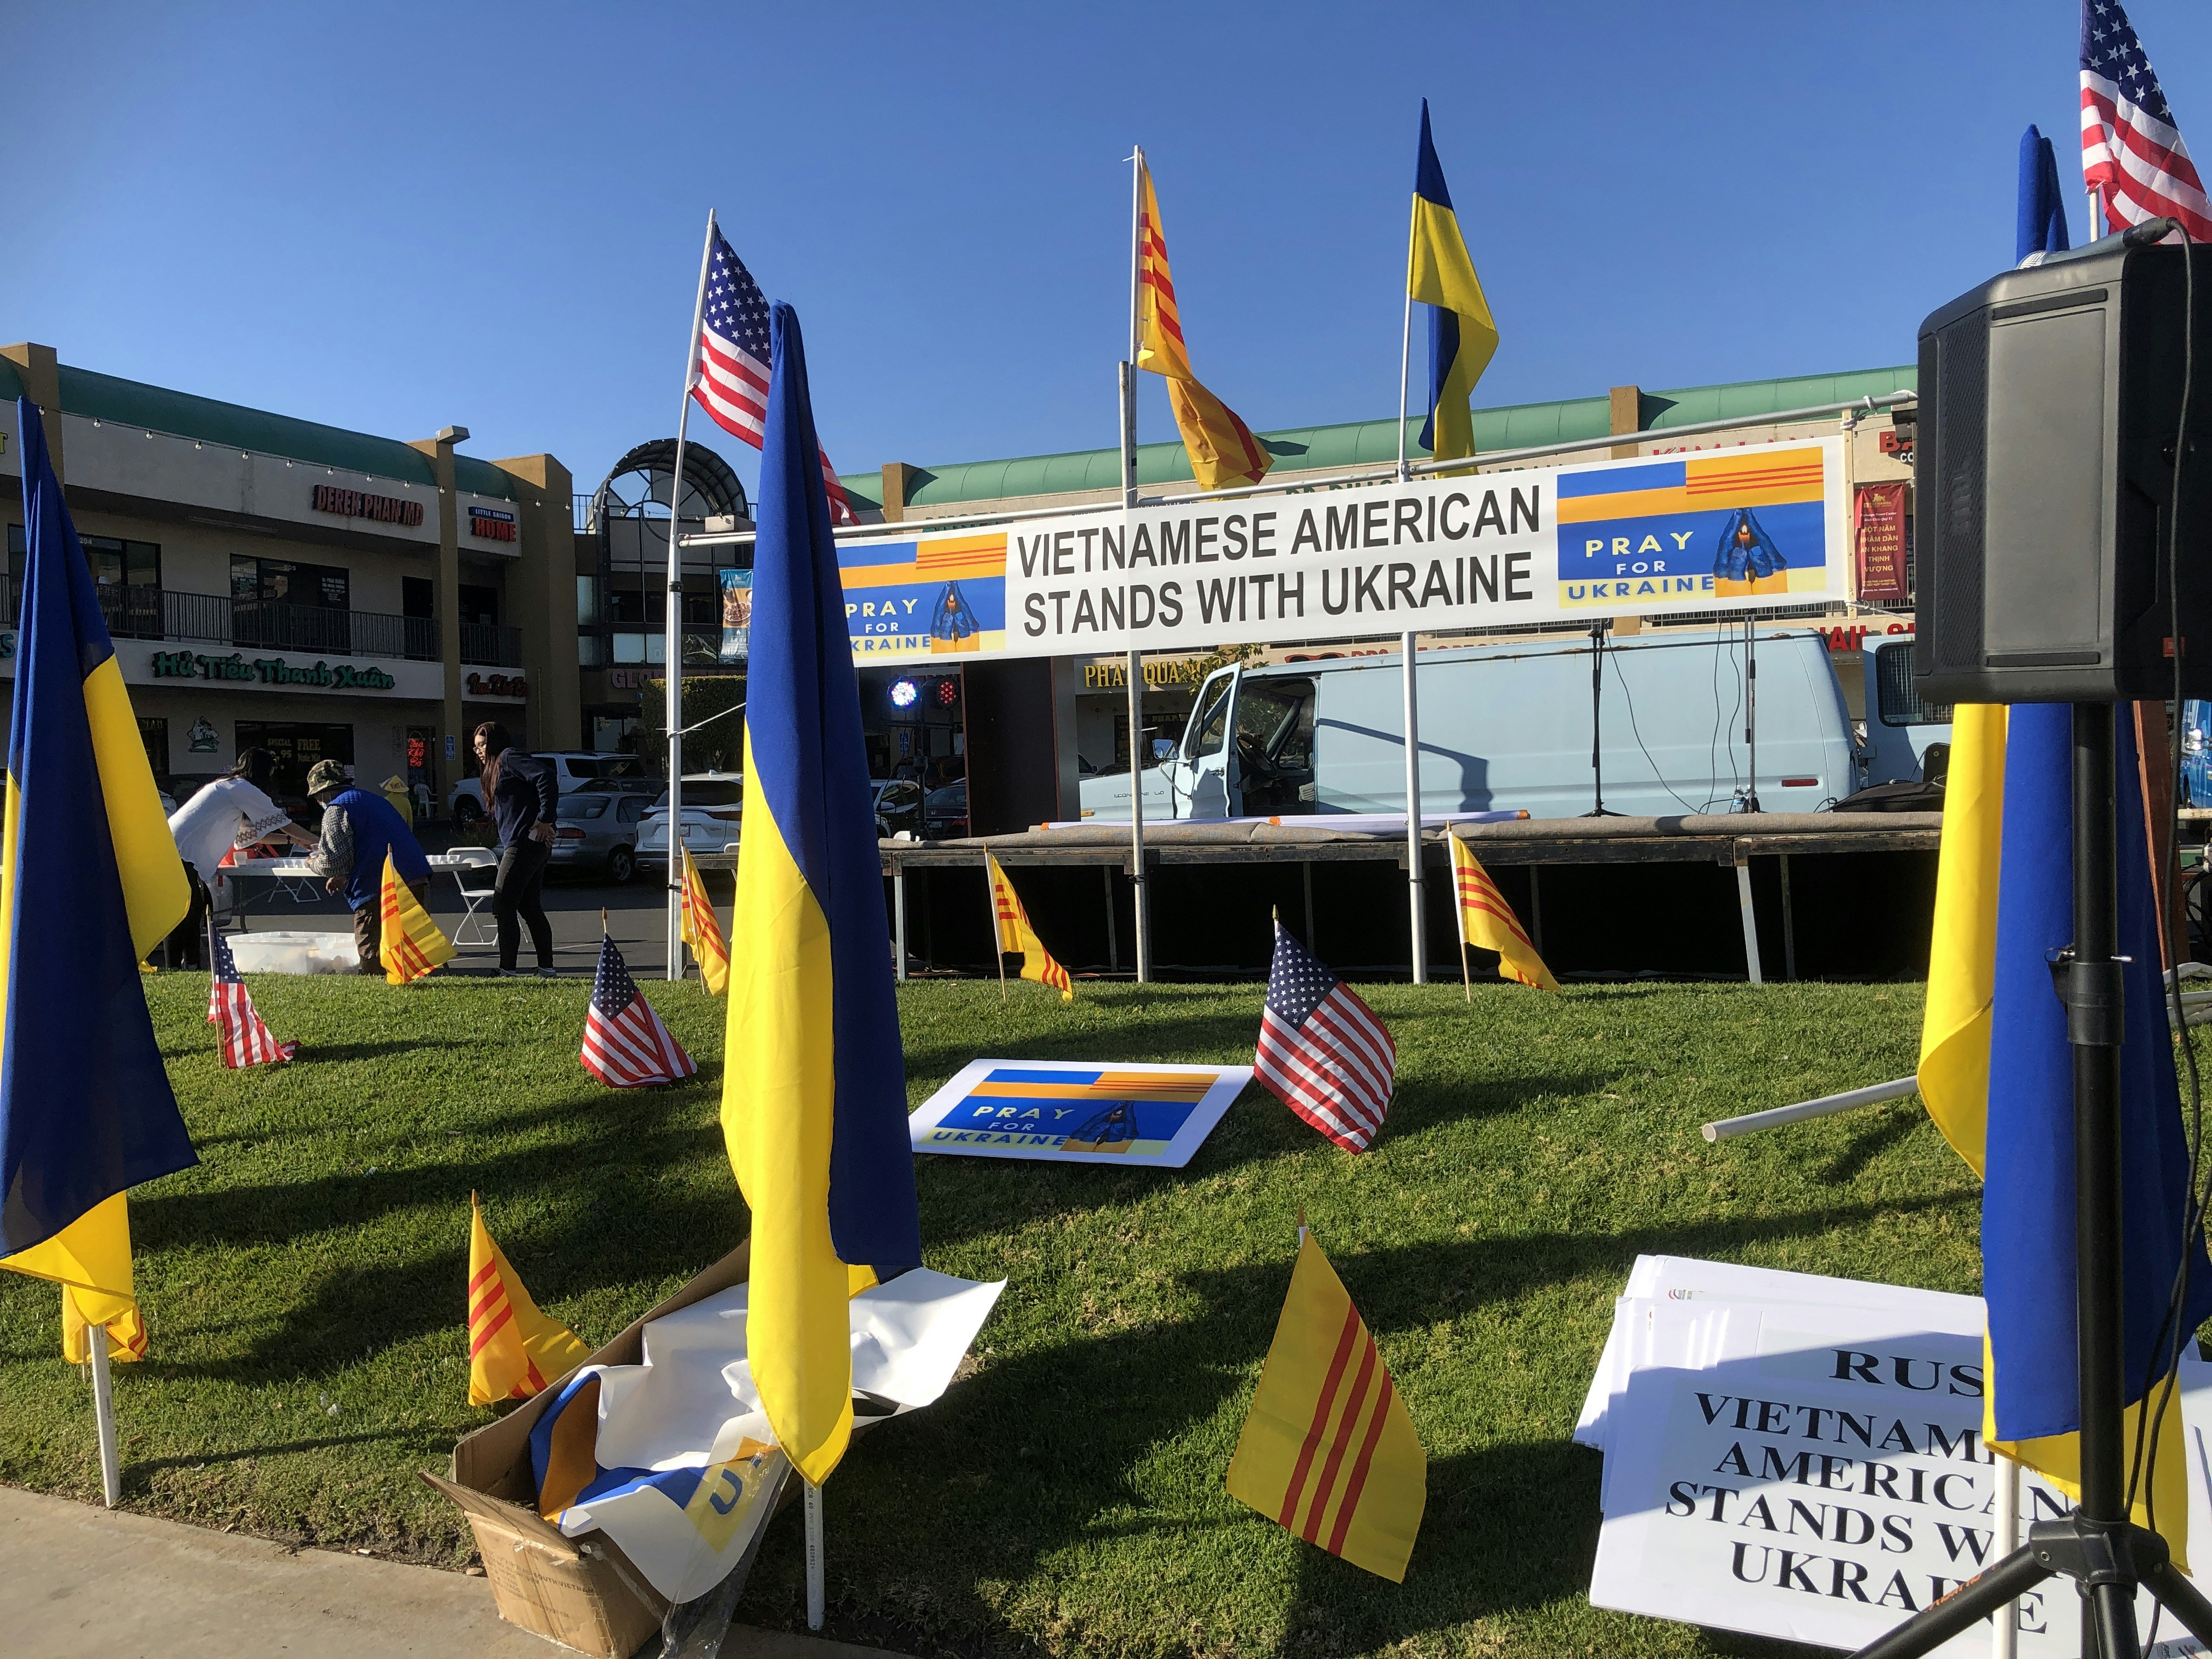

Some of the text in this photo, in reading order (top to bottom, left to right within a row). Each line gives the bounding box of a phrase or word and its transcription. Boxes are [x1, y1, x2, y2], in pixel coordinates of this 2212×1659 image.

[316, 484, 424, 526] DEREK PHAN MD
[493, 511, 511, 520] SAIGON
[475, 517, 516, 542] HOME
[1018, 485, 1539, 578] VIETNAMESE AMERICAN
[1585, 531, 1694, 557] PRAY
[1616, 560, 1666, 575] FOR
[1864, 565, 1893, 573] VƯỢNG
[1024, 552, 1533, 636] STANDS WITH UKRAINE
[1568, 576, 1714, 600] UKRAINE
[845, 599, 918, 618] PRAY
[865, 622, 899, 634] FOR
[851, 636, 930, 651] KRAINE
[255, 658, 332, 686] Thanh
[332, 664, 395, 690] Xuân
[1084, 664, 1128, 687] PHA
[297, 738, 321, 751] FREE
[972, 1106, 1074, 1120] PRAY
[988, 1122, 1035, 1131] FOR
[934, 1131, 1073, 1146] UKRAINE
[1666, 1481, 1913, 1554] STANDS
[533, 1572, 594, 1593] SOUTH VIETNAM
